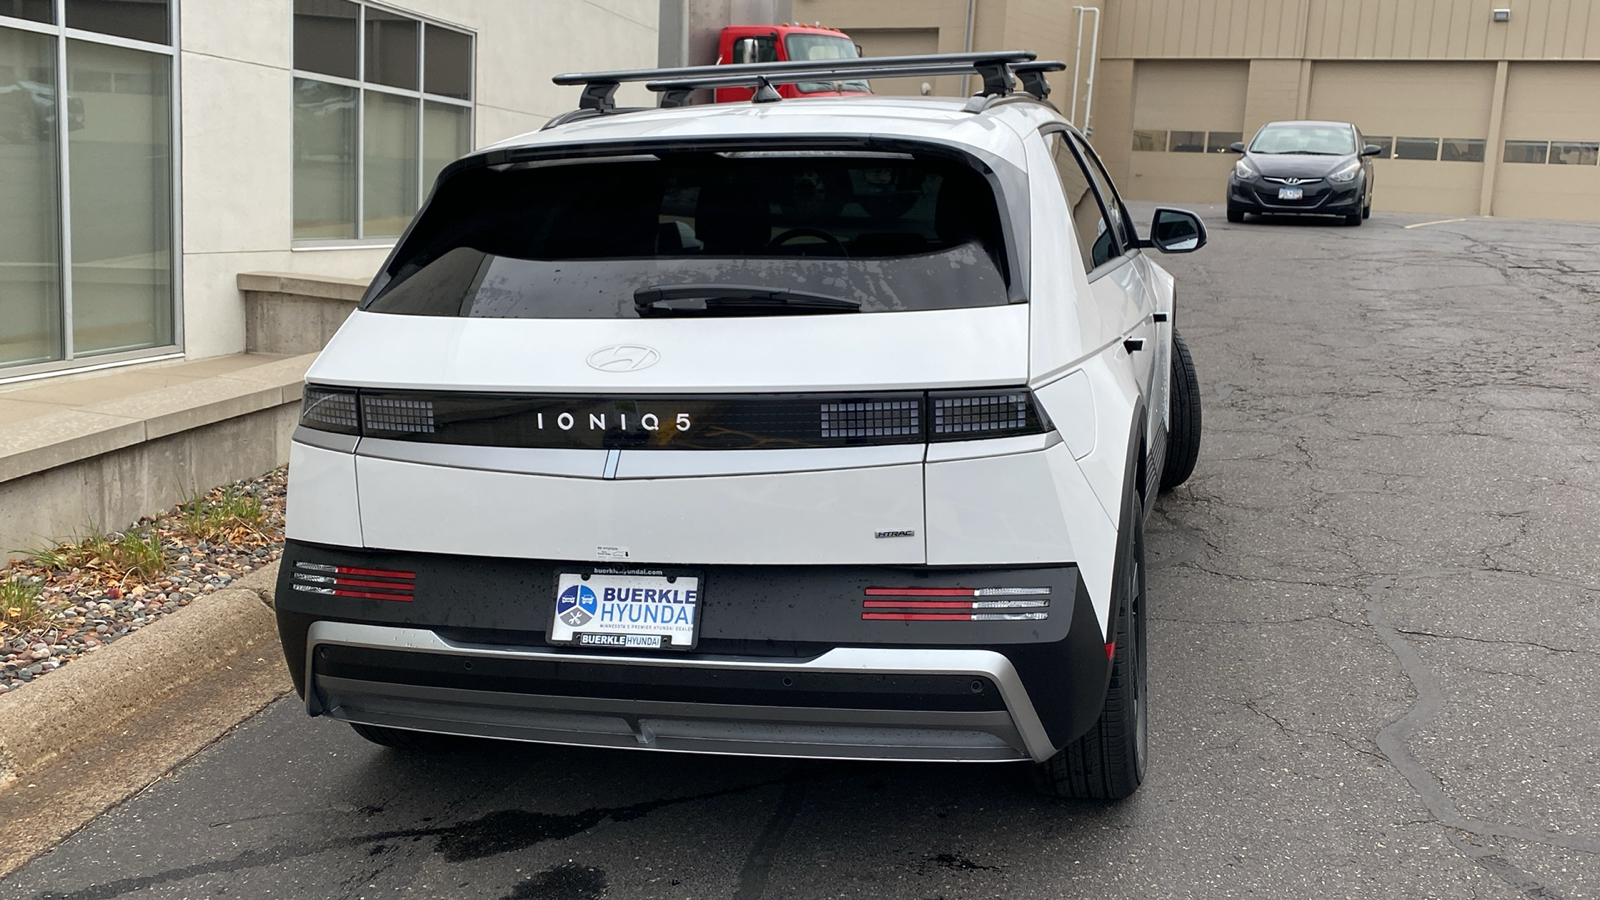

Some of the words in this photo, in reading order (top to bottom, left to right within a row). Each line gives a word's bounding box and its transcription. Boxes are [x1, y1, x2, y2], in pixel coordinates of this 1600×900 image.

[878, 530, 912, 538] HTRAC
[603, 587, 697, 605] BUERKLE
[600, 603, 696, 625] HYUNDAI
[582, 634, 626, 646] BUERKLE
[626, 636, 660, 647] HYUNDAI
